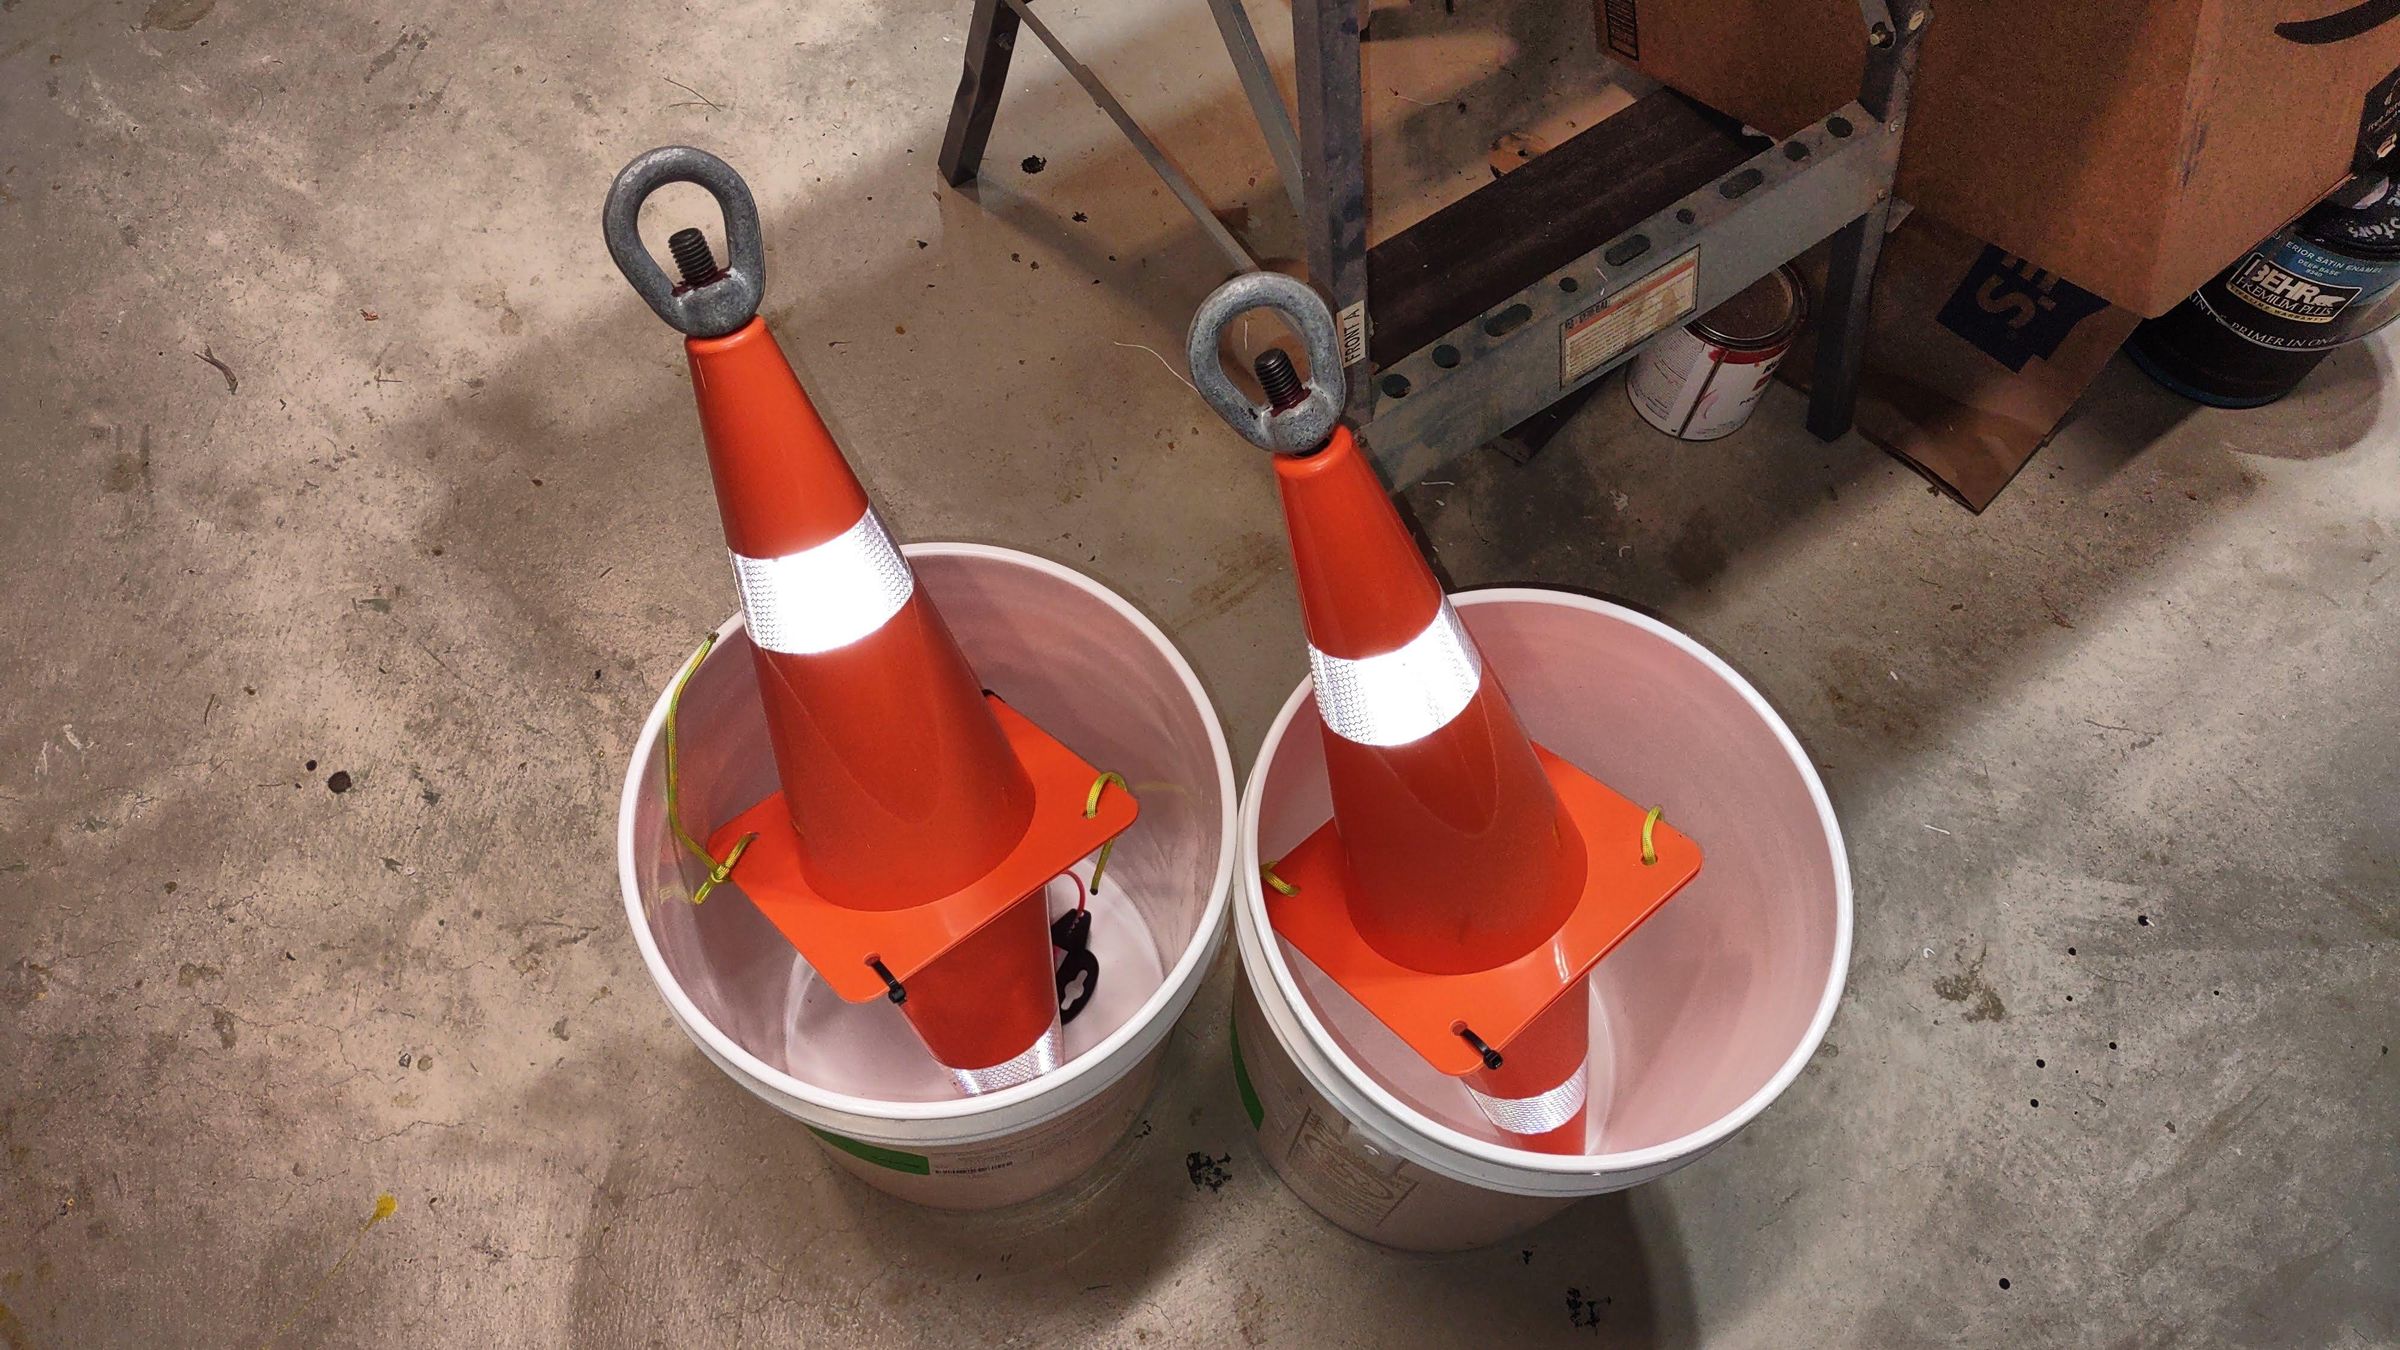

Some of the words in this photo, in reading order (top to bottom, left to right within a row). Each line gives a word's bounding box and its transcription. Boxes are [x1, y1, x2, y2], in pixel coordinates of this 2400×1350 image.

[2315, 256, 2345, 269] SATIN
[2235, 277, 2297, 312] PREMIUM
[2300, 304, 2333, 316] PLUS
[2245, 259, 2320, 304] BEHR
[1344, 308, 1360, 321] A
[1344, 323, 1361, 363] FRONT
[2231, 322, 2284, 346] PRIMER
[2286, 339, 2306, 347] IN
